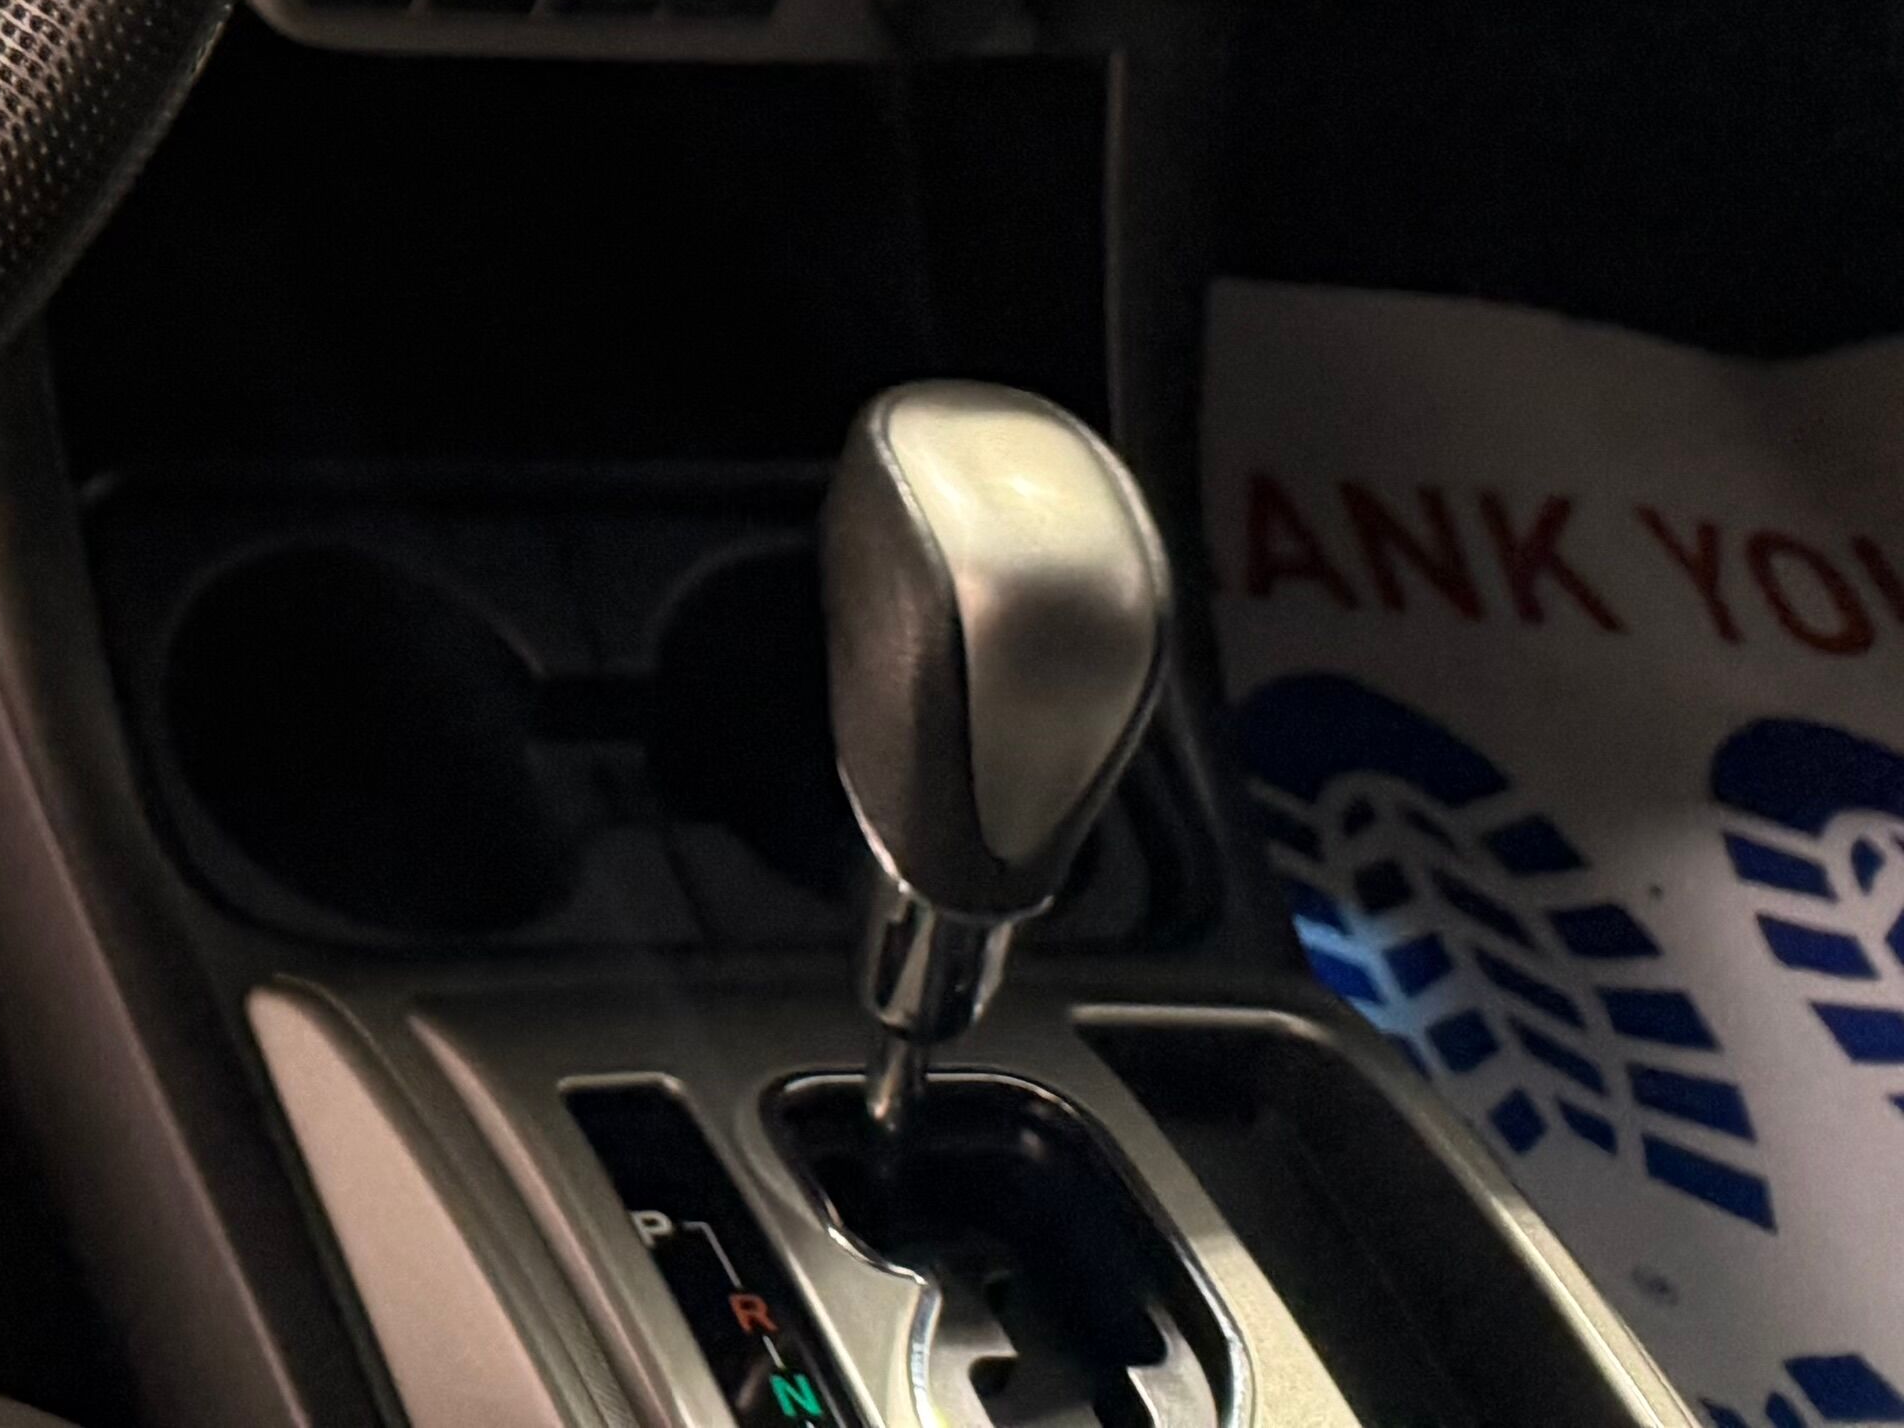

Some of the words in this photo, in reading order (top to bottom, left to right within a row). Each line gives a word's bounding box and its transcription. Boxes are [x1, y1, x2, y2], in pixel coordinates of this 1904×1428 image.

[632, 1209, 672, 1244] P
[729, 1294, 776, 1336] R
[770, 1373, 823, 1417] N
